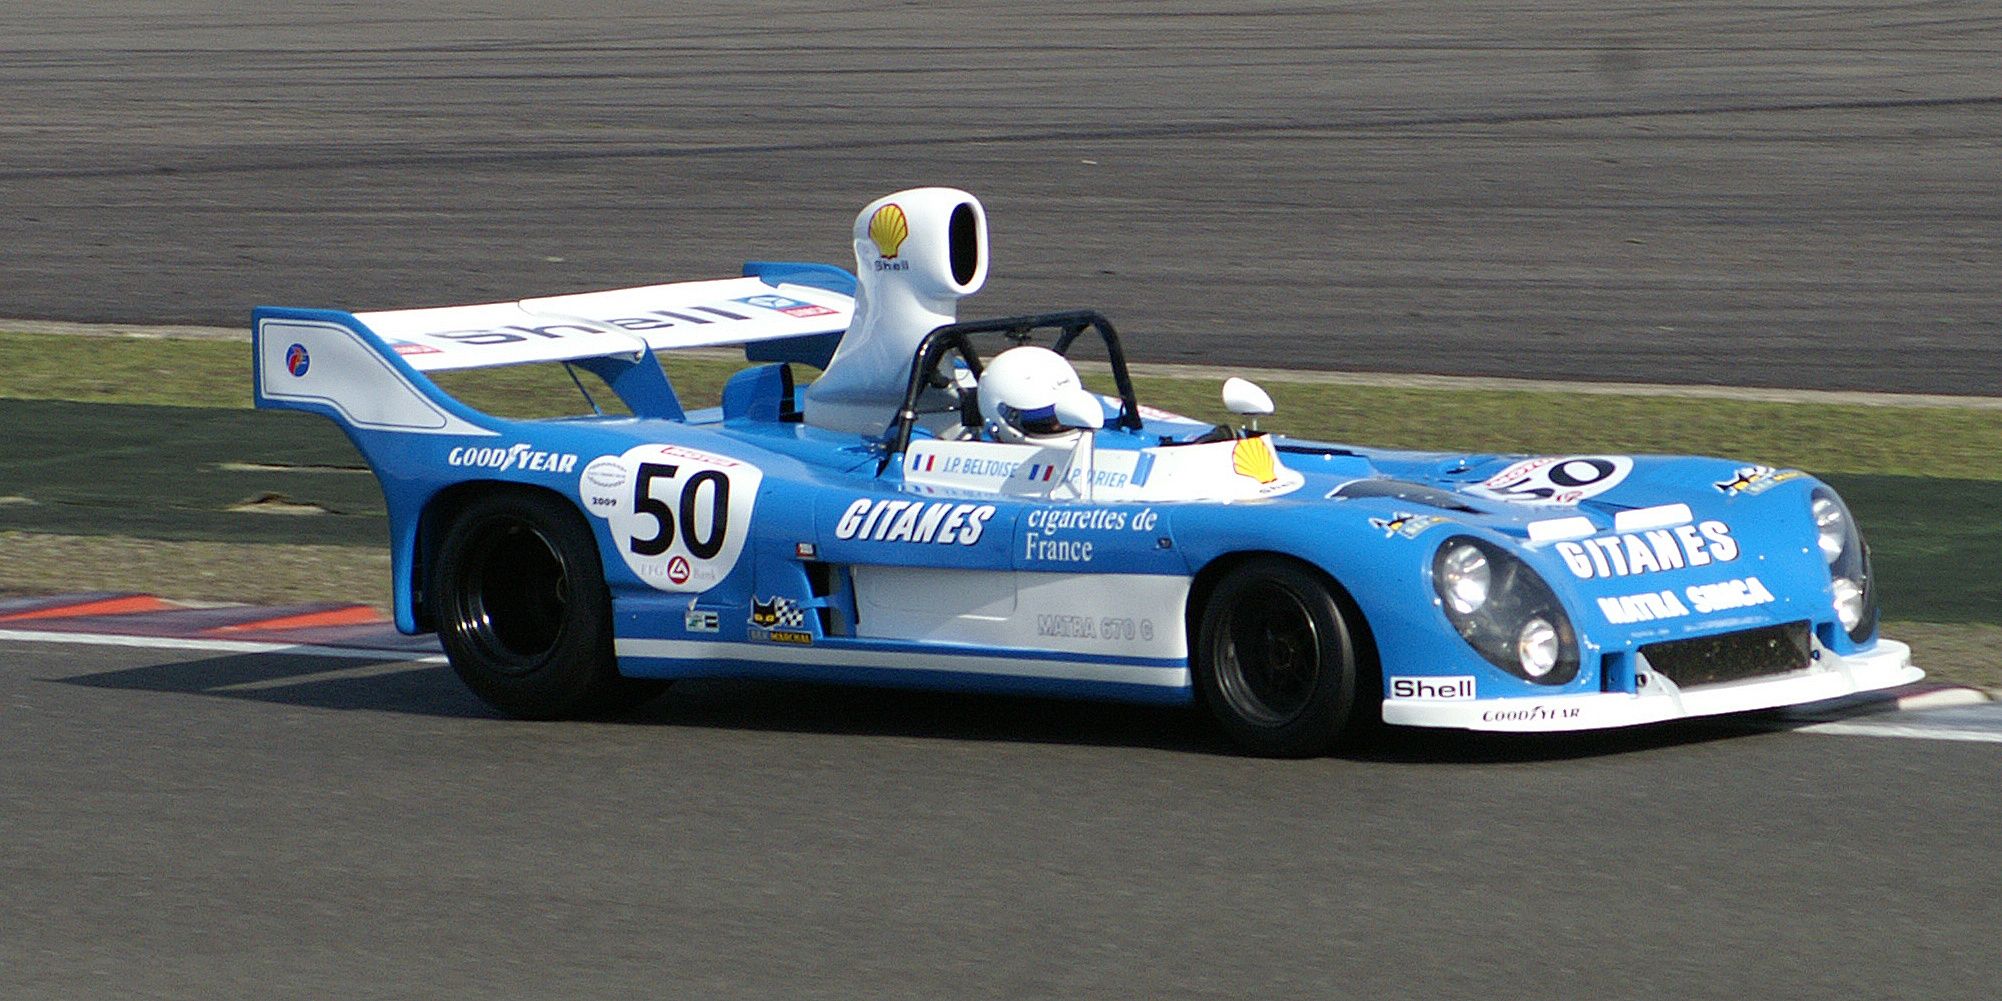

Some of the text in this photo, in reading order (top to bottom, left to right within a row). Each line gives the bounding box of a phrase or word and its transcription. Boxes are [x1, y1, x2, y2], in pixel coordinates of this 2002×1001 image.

[425, 306, 752, 345] Shell
[448, 443, 578, 473] GOODYEAR
[962, 458, 1020, 478] BELTOISE
[1488, 458, 1616, 501] 50
[591, 496, 618, 507] 2009
[630, 462, 730, 560] 50
[834, 498, 996, 546] GITANES
[1028, 507, 1158, 534] cigarettes de
[1025, 533, 1093, 562] France
[1555, 520, 1740, 580] GITANES
[1394, 680, 1471, 698] Shell
[1482, 706, 1580, 722] GOODYEAR
